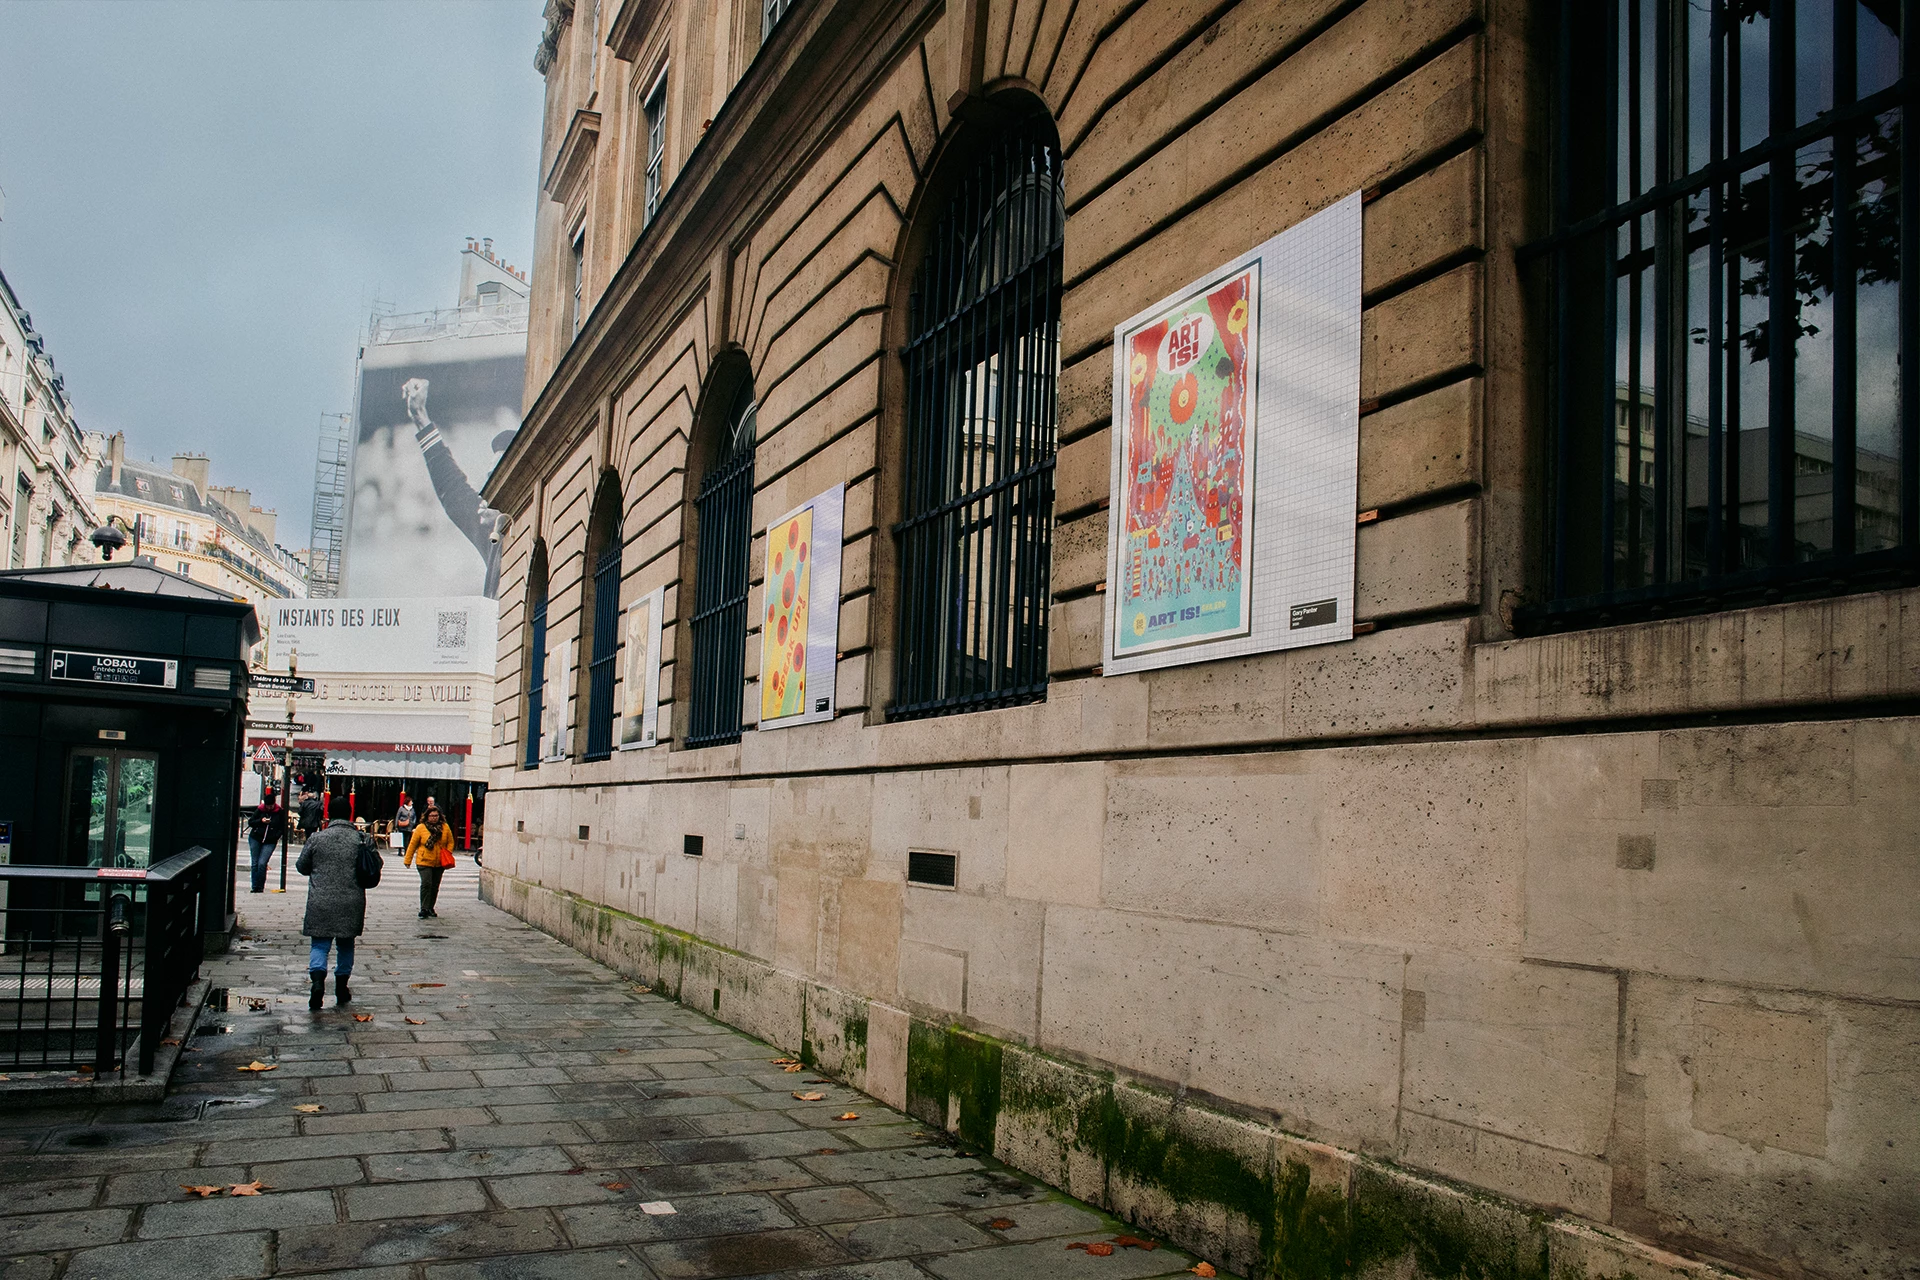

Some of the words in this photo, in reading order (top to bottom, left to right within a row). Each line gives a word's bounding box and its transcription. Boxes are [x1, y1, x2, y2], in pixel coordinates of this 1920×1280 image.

[1168, 316, 1202, 354] ART
[1169, 341, 1199, 371] IS!
[278, 608, 334, 627] INSTANTS
[341, 608, 364, 627] DES
[371, 608, 400, 627] JEUX
[1148, 611, 1177, 628] ART
[1179, 605, 1200, 621] IS!
[1292, 609, 1303, 617] Gary
[778, 639, 795, 699] SPEAK
[793, 594, 806, 632] UP!
[53, 659, 65, 671] P
[92, 665, 116, 673] Entrée
[116, 667, 141, 675] RIVOLI
[96, 657, 137, 669] LOBAU
[404, 685, 421, 702] DE
[430, 685, 472, 702] VILLE
[270, 738, 285, 747] CAF
[394, 743, 450, 753] RESTAURANT
